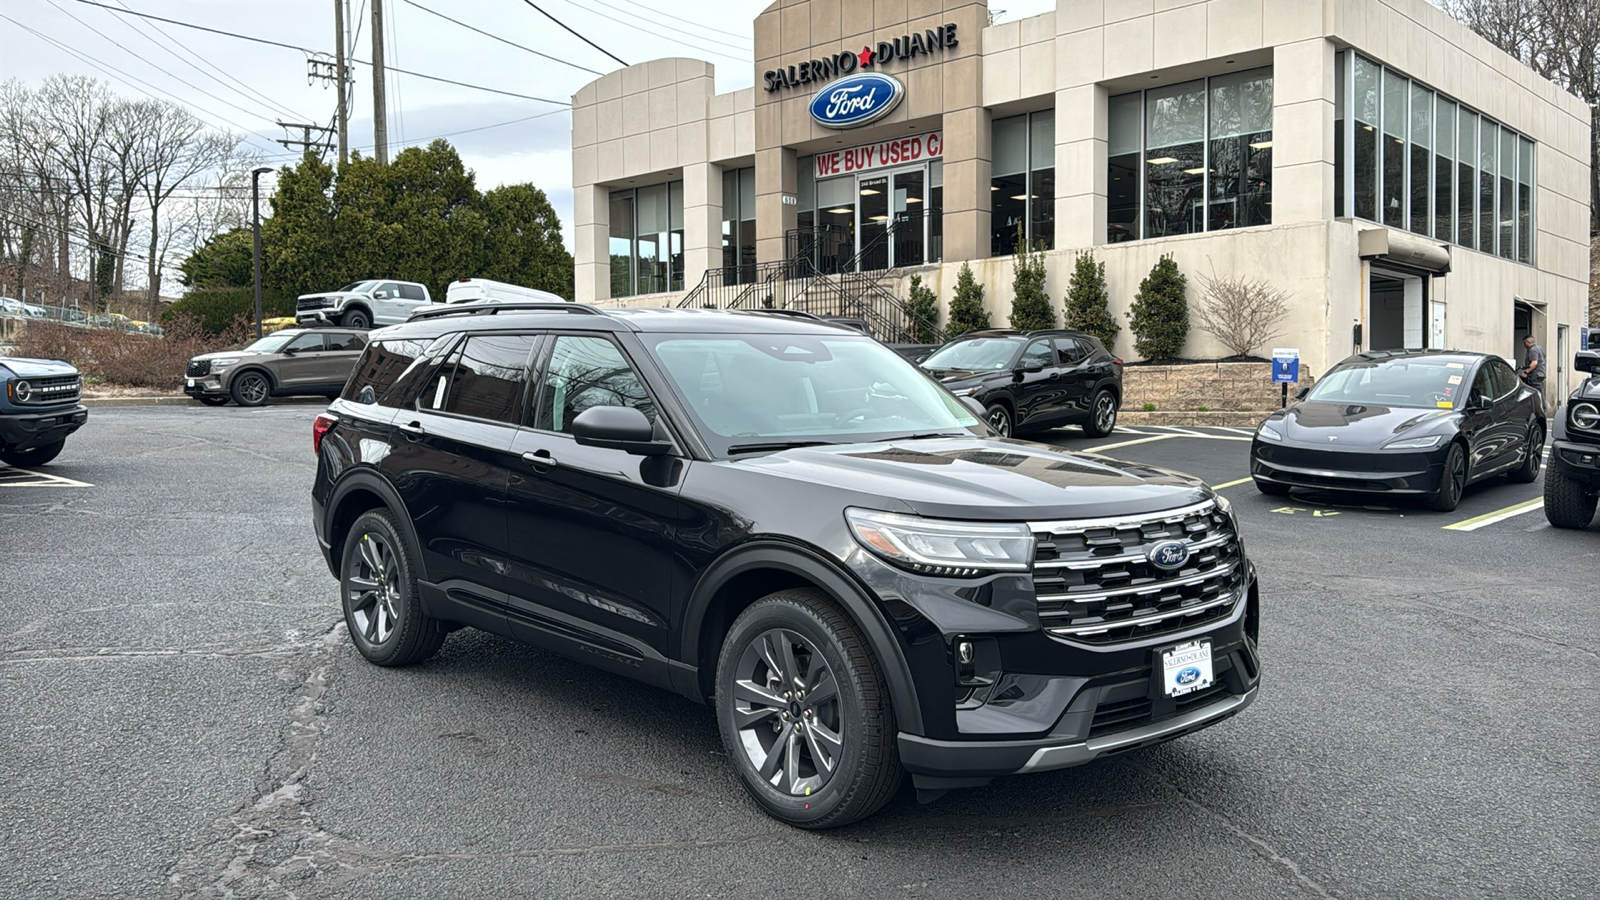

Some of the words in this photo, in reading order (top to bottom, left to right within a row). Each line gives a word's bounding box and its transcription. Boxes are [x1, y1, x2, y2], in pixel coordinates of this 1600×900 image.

[763, 50, 858, 93] SALERNO
[876, 23, 959, 64] DUANE
[826, 85, 875, 118] Ford
[817, 152, 840, 176] WE
[845, 146, 875, 172] BUY
[879, 137, 922, 166] USED
[42, 384, 77, 392] BRONCO
[1162, 546, 1184, 563] Ford
[1164, 654, 1189, 667] SALERNO
[1190, 650, 1210, 660] DUANE
[1180, 669, 1197, 683] Ford
